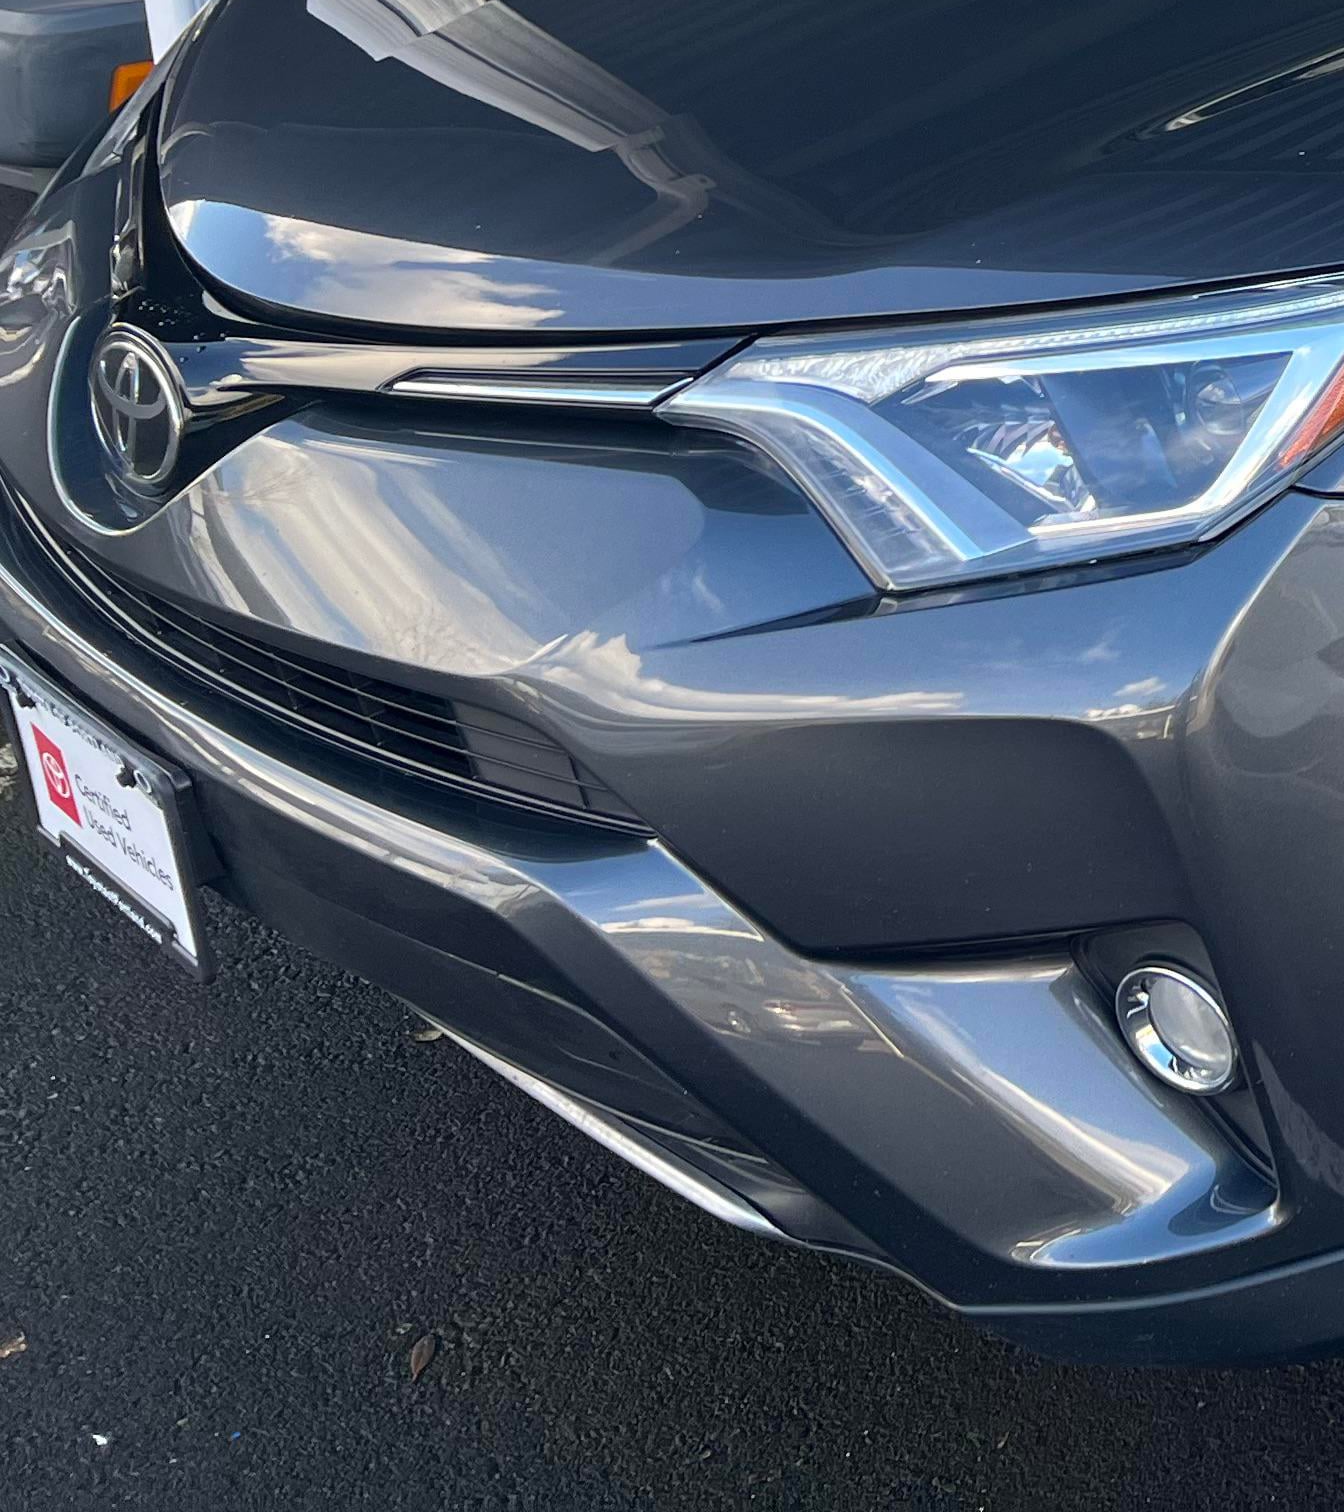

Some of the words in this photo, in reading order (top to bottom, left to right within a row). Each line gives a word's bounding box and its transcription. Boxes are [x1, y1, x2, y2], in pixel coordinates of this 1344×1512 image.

[74, 773, 132, 832] Certified
[83, 803, 118, 848] Used
[116, 831, 174, 892] Vehicles
